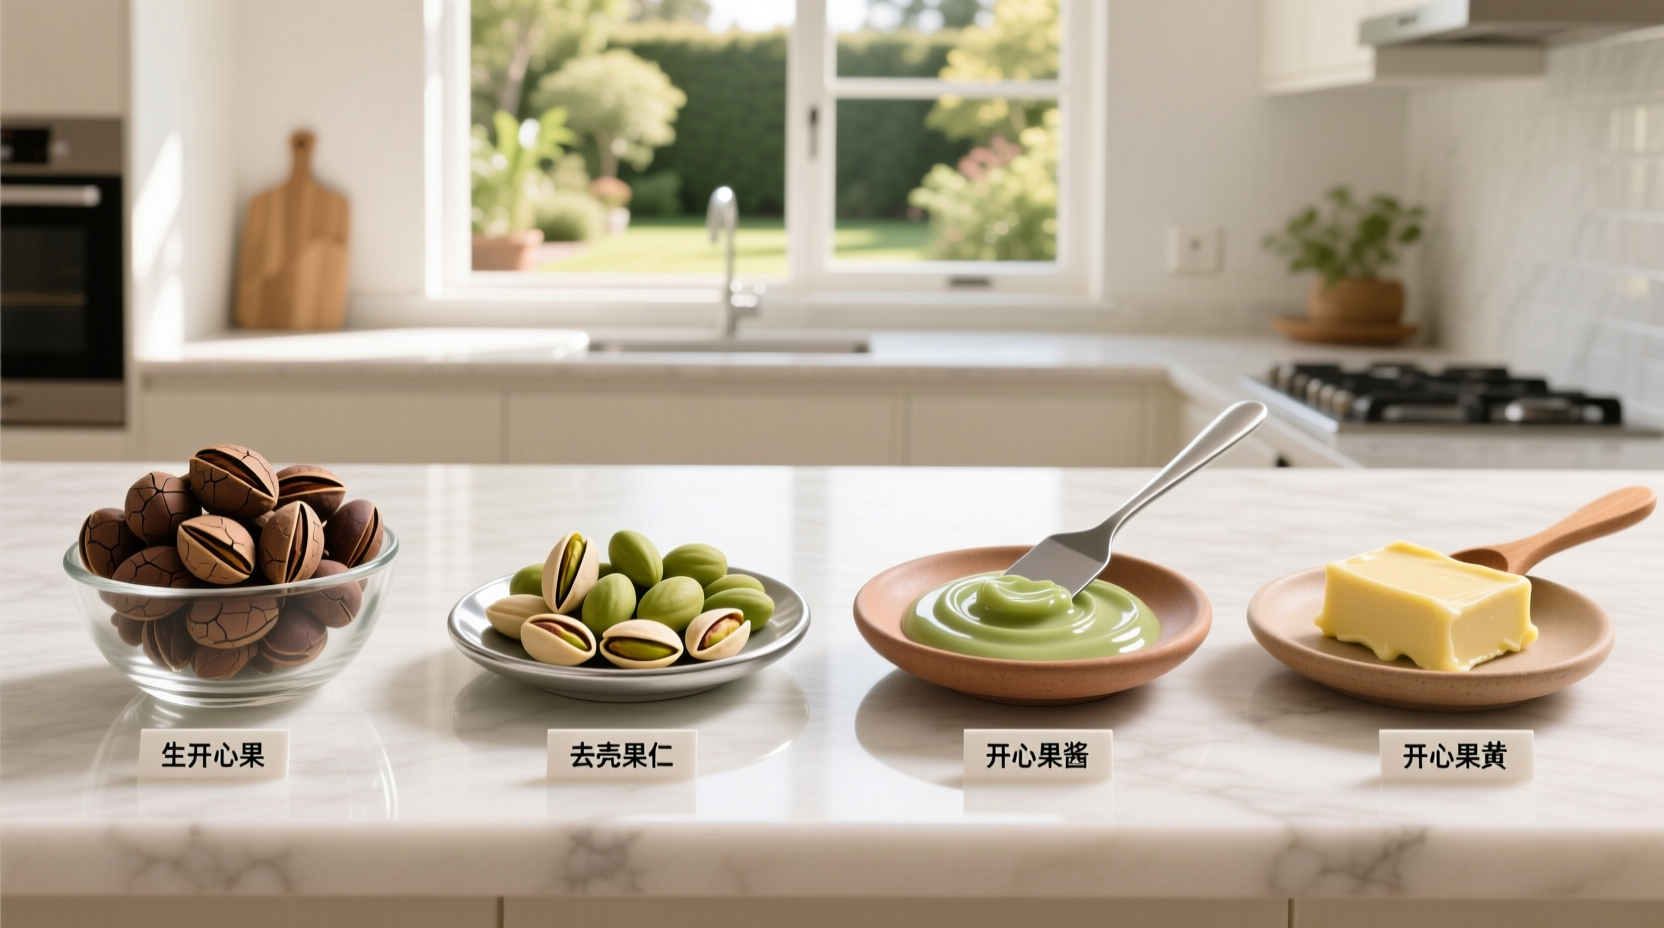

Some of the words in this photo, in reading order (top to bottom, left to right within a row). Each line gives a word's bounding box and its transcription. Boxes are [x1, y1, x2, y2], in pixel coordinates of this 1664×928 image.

[161, 741, 265, 769] 生开心果
[569, 741, 674, 769] 去壳果仁
[985, 741, 1089, 769] 开心果酱
[1402, 740, 1508, 770] 开心果黄
